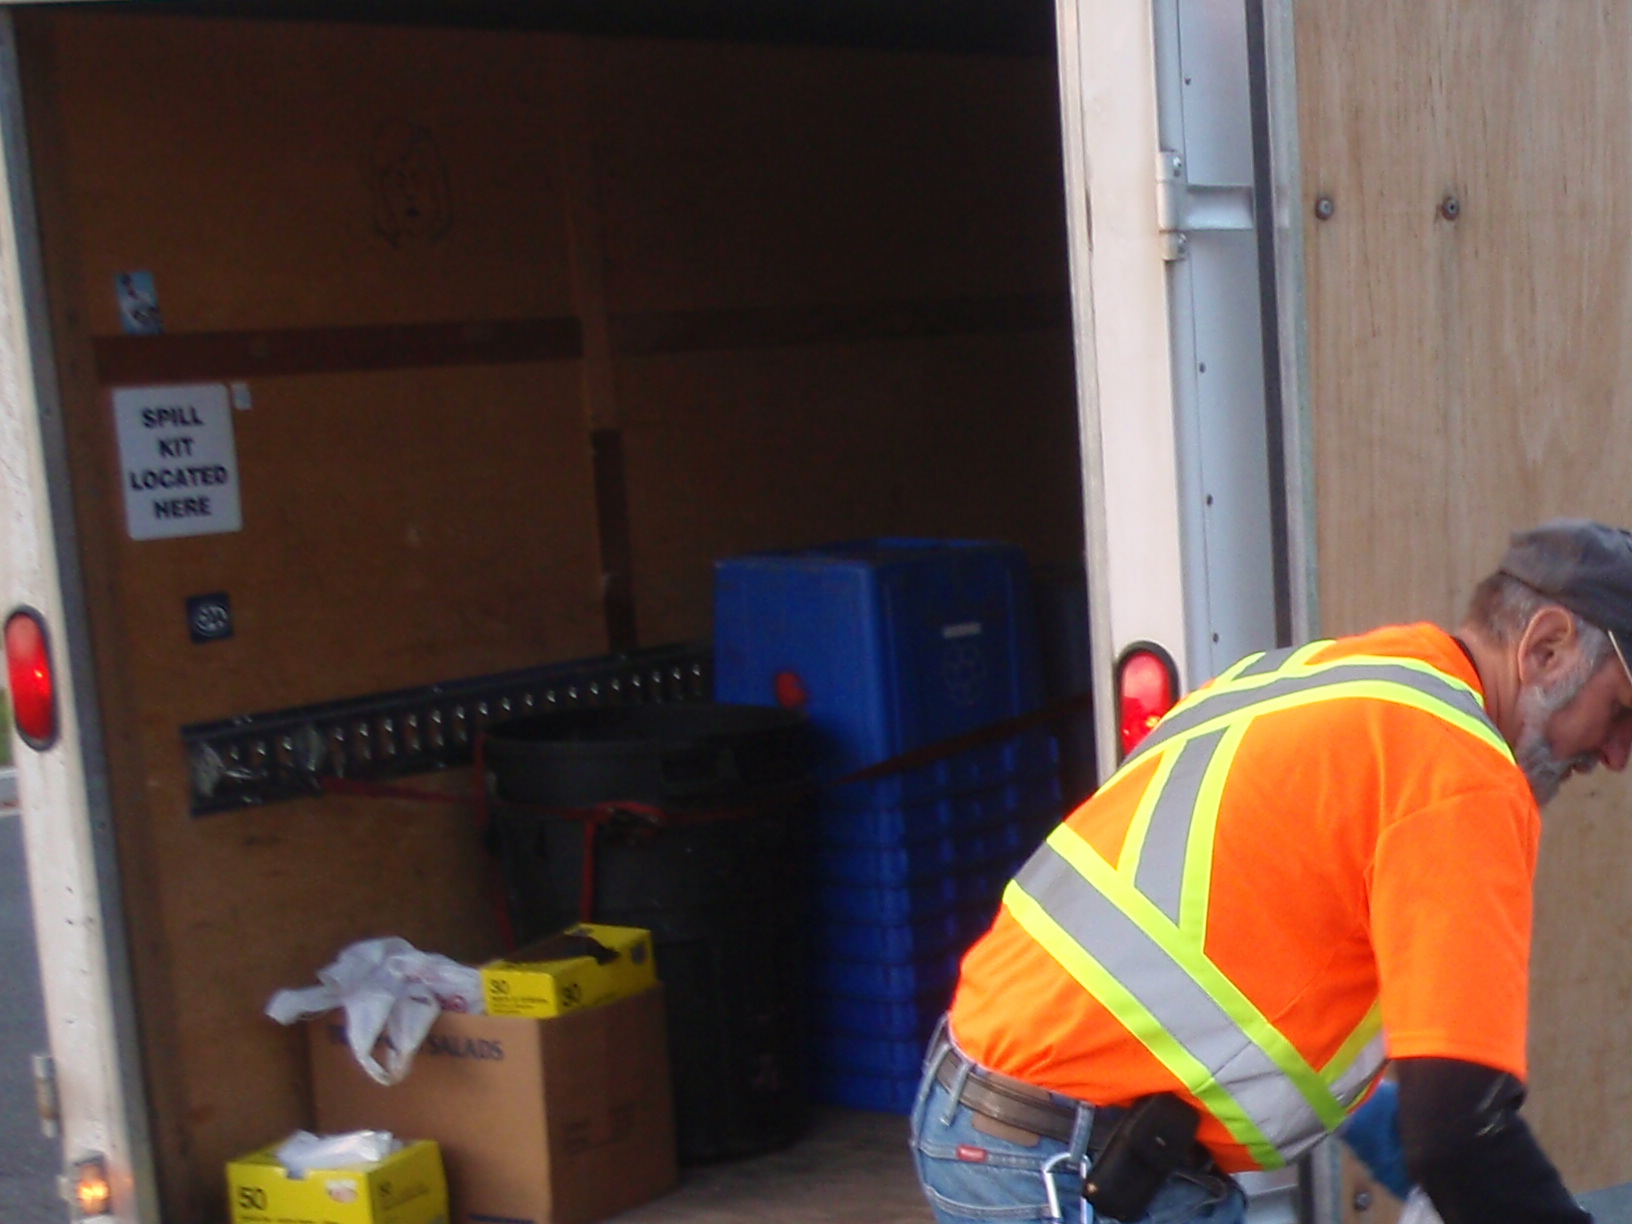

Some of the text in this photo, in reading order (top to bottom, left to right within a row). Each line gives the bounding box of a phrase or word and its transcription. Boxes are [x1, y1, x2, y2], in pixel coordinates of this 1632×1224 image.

[142, 405, 204, 429] SPILL
[158, 437, 195, 458] KIT
[129, 464, 228, 491] LOCATED
[154, 494, 213, 520] HERE
[238, 1186, 268, 1212] 50
